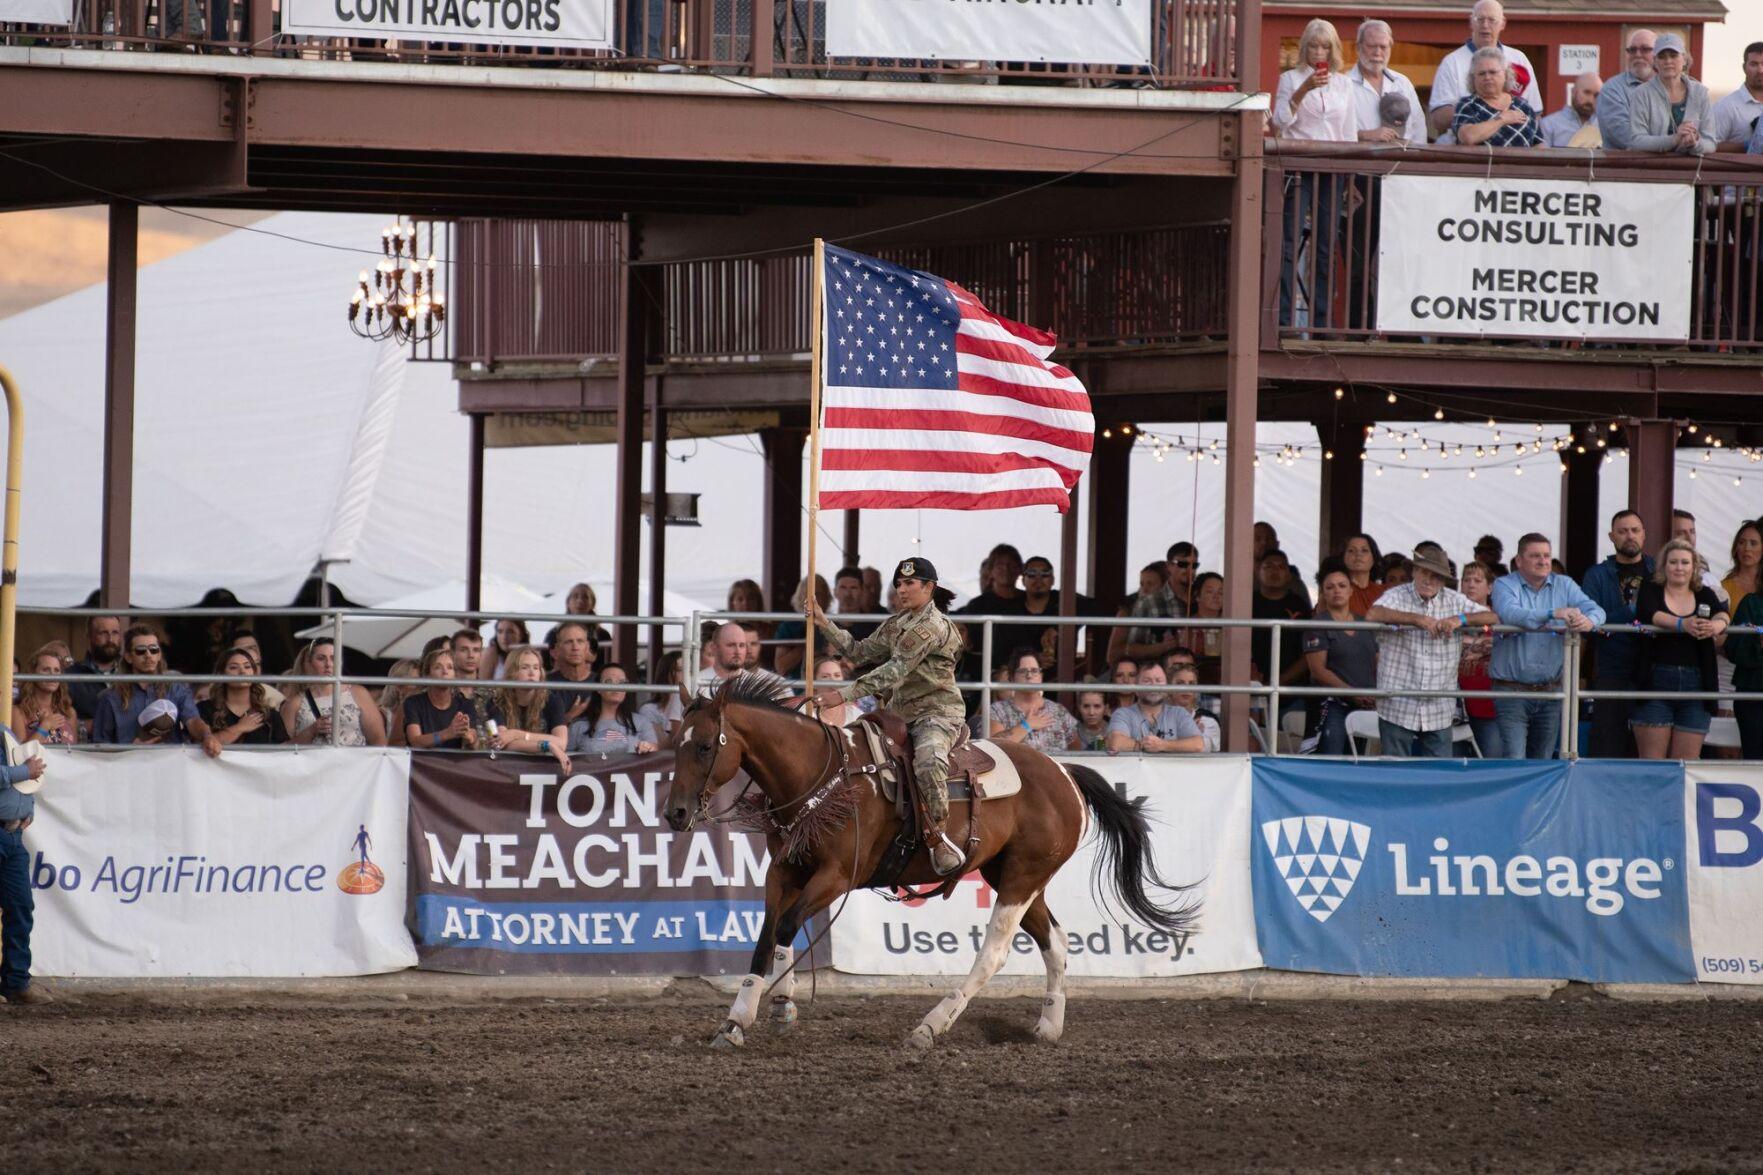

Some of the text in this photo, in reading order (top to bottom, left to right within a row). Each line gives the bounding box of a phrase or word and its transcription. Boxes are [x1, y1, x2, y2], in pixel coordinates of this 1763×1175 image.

[335, 0, 561, 32] CONTRACTORS
[1562, 48, 1597, 58] STATION
[1576, 60, 1583, 70] 3
[1474, 189, 1602, 217] MERCER
[1437, 218, 1639, 247] CONSULTING
[1472, 267, 1599, 295] MERCER
[1410, 295, 1660, 326] CONSTRUCTION
[519, 772, 675, 828] TON
[424, 831, 773, 889] MEACHAM
[31, 851, 326, 903] bo AgriFinance
[441, 906, 640, 945] ATTORNEY
[652, 917, 685, 938] AT
[883, 922, 1195, 962] Use te ed key.
[1703, 956, 1763, 974] (509) 5
